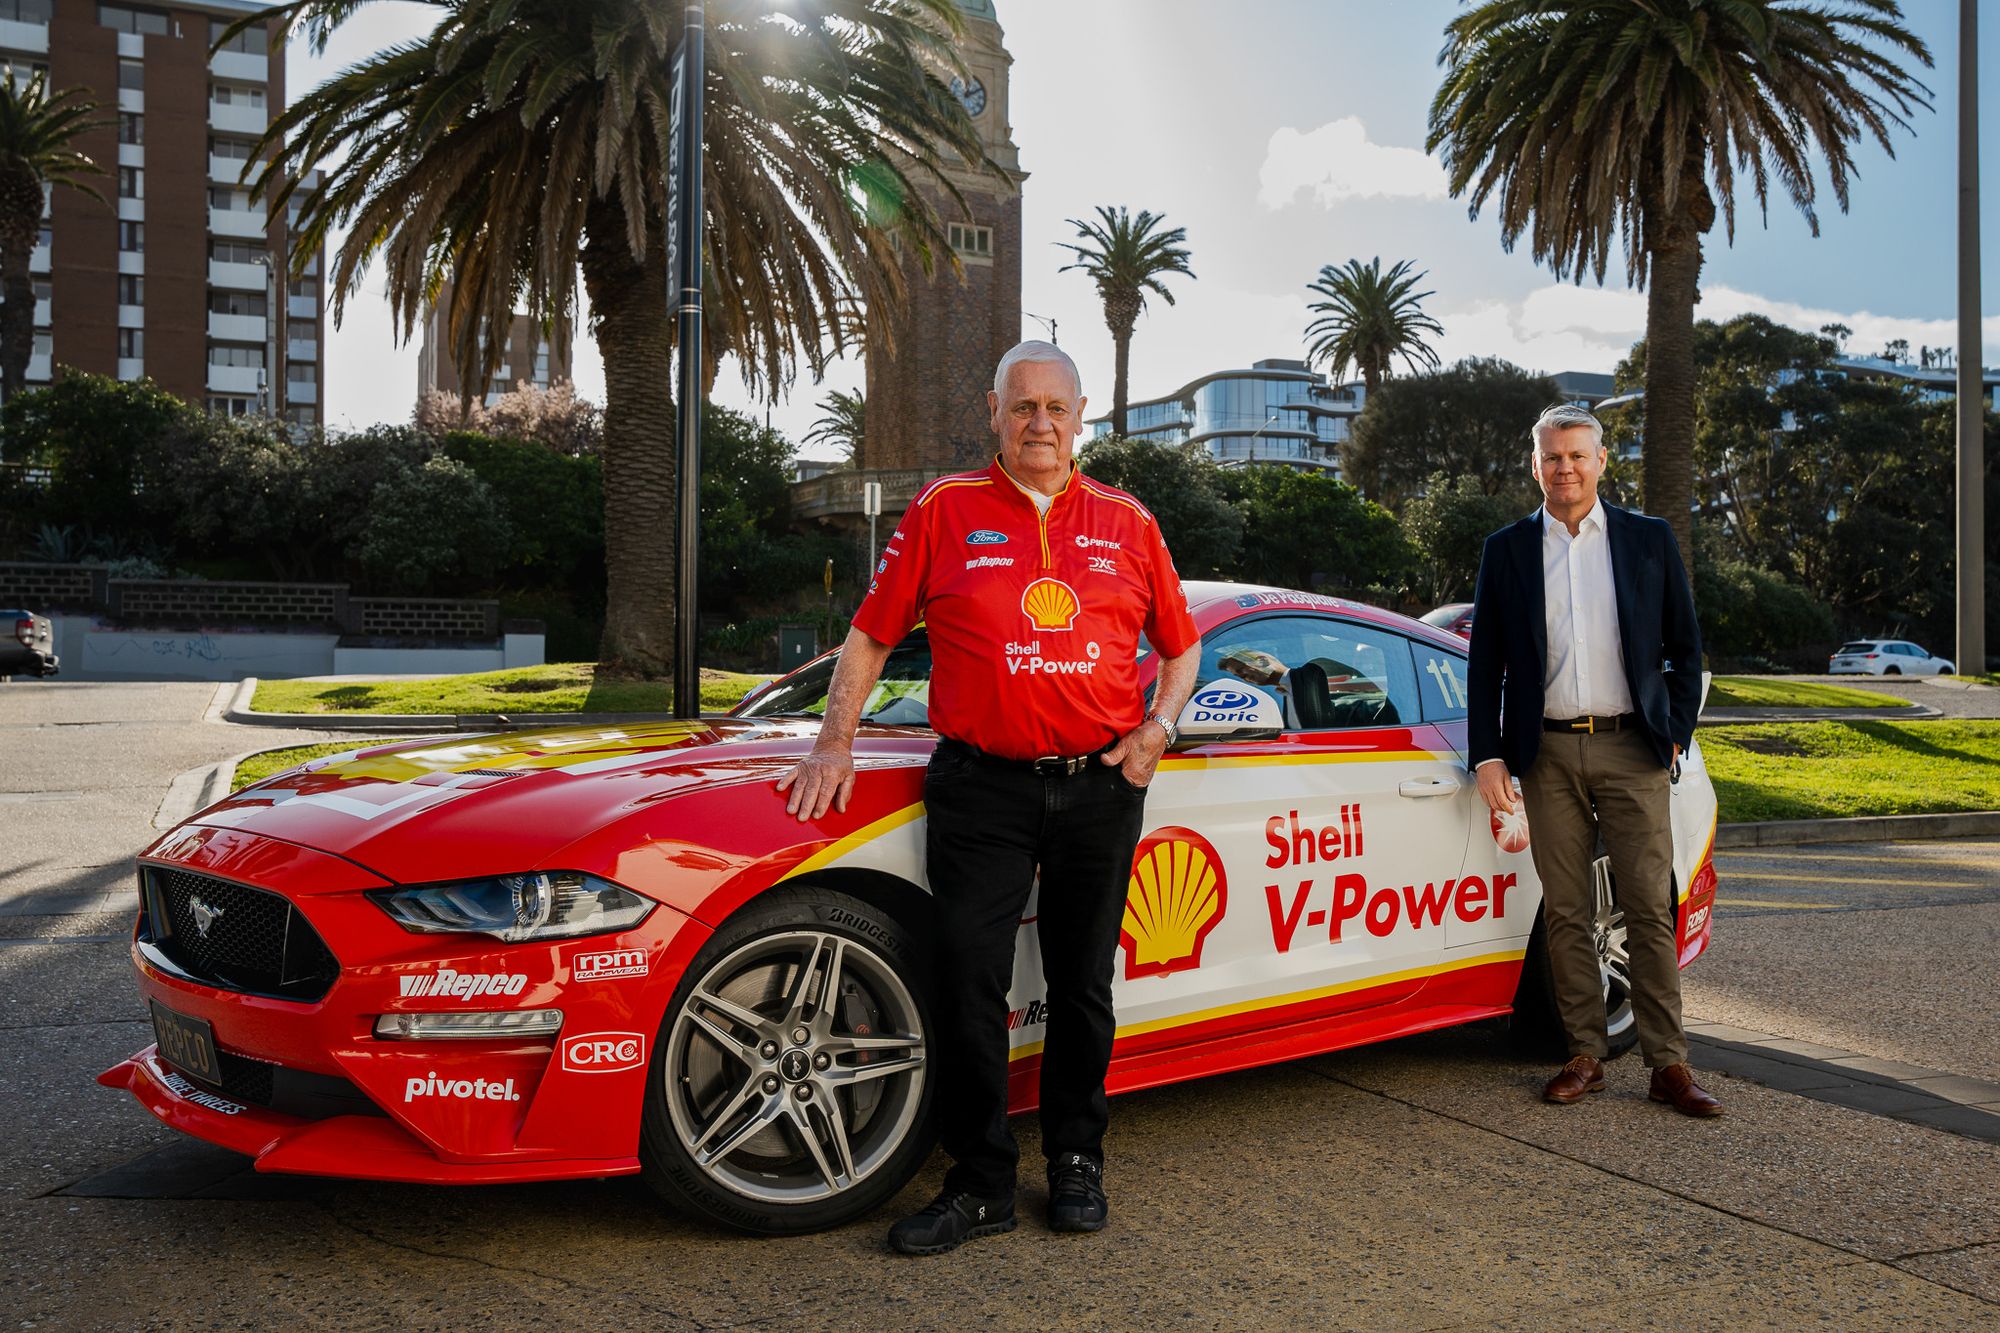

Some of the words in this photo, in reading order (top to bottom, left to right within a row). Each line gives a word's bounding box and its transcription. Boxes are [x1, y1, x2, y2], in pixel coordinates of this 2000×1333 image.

[973, 531, 1000, 543] Ford
[1089, 538, 1121, 550] PIRTEK
[1257, 592, 1280, 605] De
[1279, 592, 1340, 610] Pasquale
[1005, 640, 1040, 655] Shell
[1006, 656, 1097, 675] V-Power
[1426, 658, 1468, 709] 11
[1193, 710, 1260, 723] Doric
[1265, 803, 1364, 869] Shell
[1264, 872, 1518, 954] V-Power
[1687, 905, 1709, 932] FORD
[827, 907, 905, 955] BRIDGEST
[579, 951, 645, 972] rpm
[428, 969, 528, 1002] Repco
[156, 1015, 210, 1074] REPCO
[569, 1040, 639, 1065] CRC
[164, 1072, 197, 1097] THREE
[183, 1090, 248, 1115] THREES
